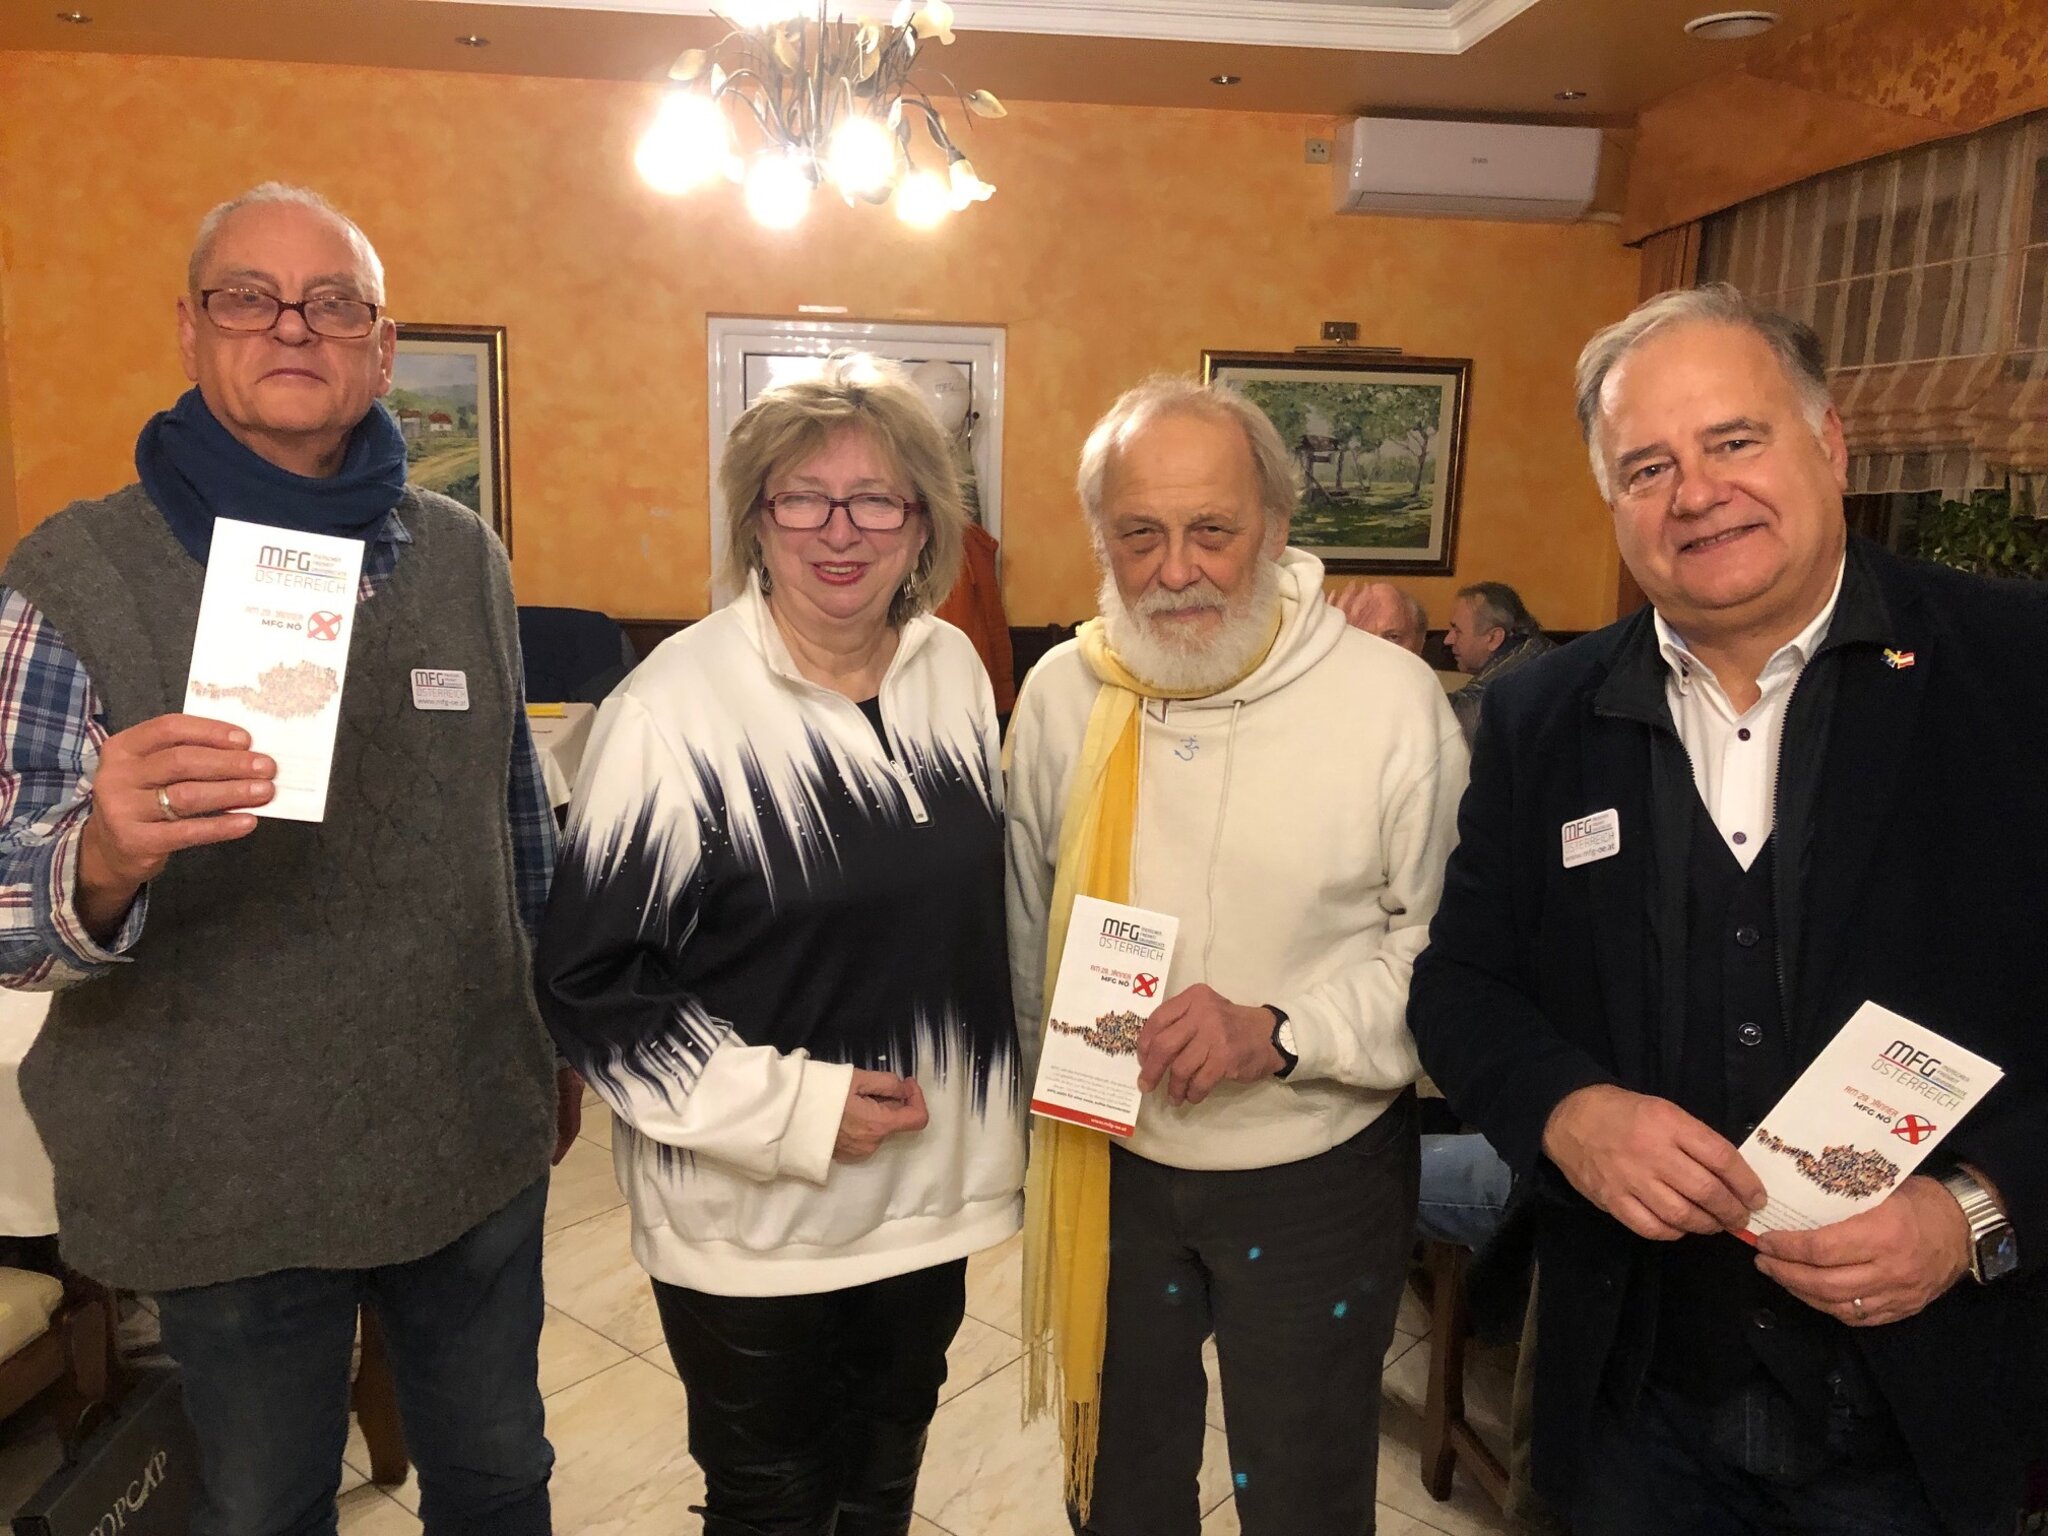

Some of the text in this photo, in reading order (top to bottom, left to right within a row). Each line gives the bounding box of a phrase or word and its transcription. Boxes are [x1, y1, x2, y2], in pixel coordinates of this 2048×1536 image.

[259, 545, 312, 572] MFG
[261, 618, 284, 629] MFG
[415, 671, 445, 686] MFG
[1564, 818, 1592, 841] MFG
[1102, 917, 1141, 941] MFG
[1101, 975, 1117, 985] MFG
[1883, 1040, 1942, 1078] MFG
[1853, 1101, 1876, 1117] MFG
